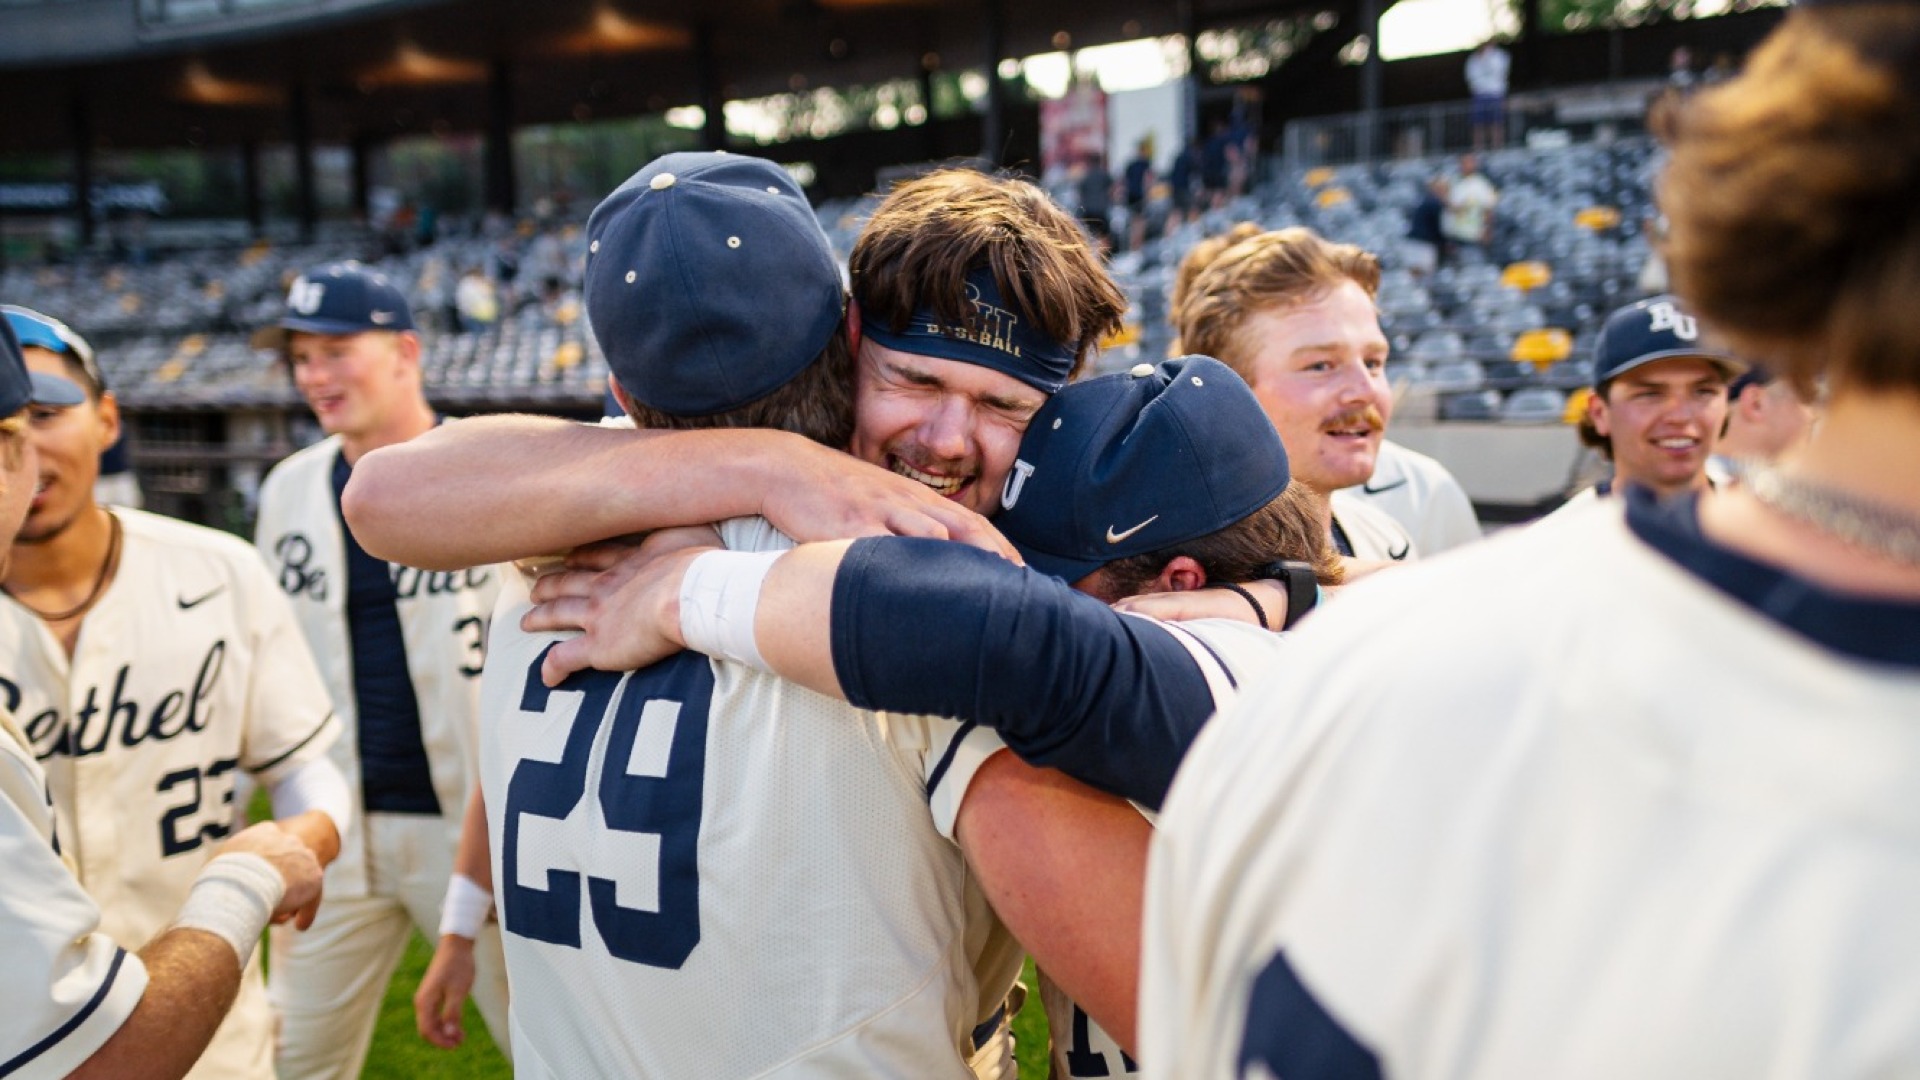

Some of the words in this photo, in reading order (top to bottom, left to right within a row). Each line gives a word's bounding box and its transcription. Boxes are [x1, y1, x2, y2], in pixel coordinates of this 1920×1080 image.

[926, 323, 1021, 358] BSEBALL
[1648, 301, 1697, 341] BU
[156, 756, 241, 857] 23
[502, 640, 715, 970] 29
